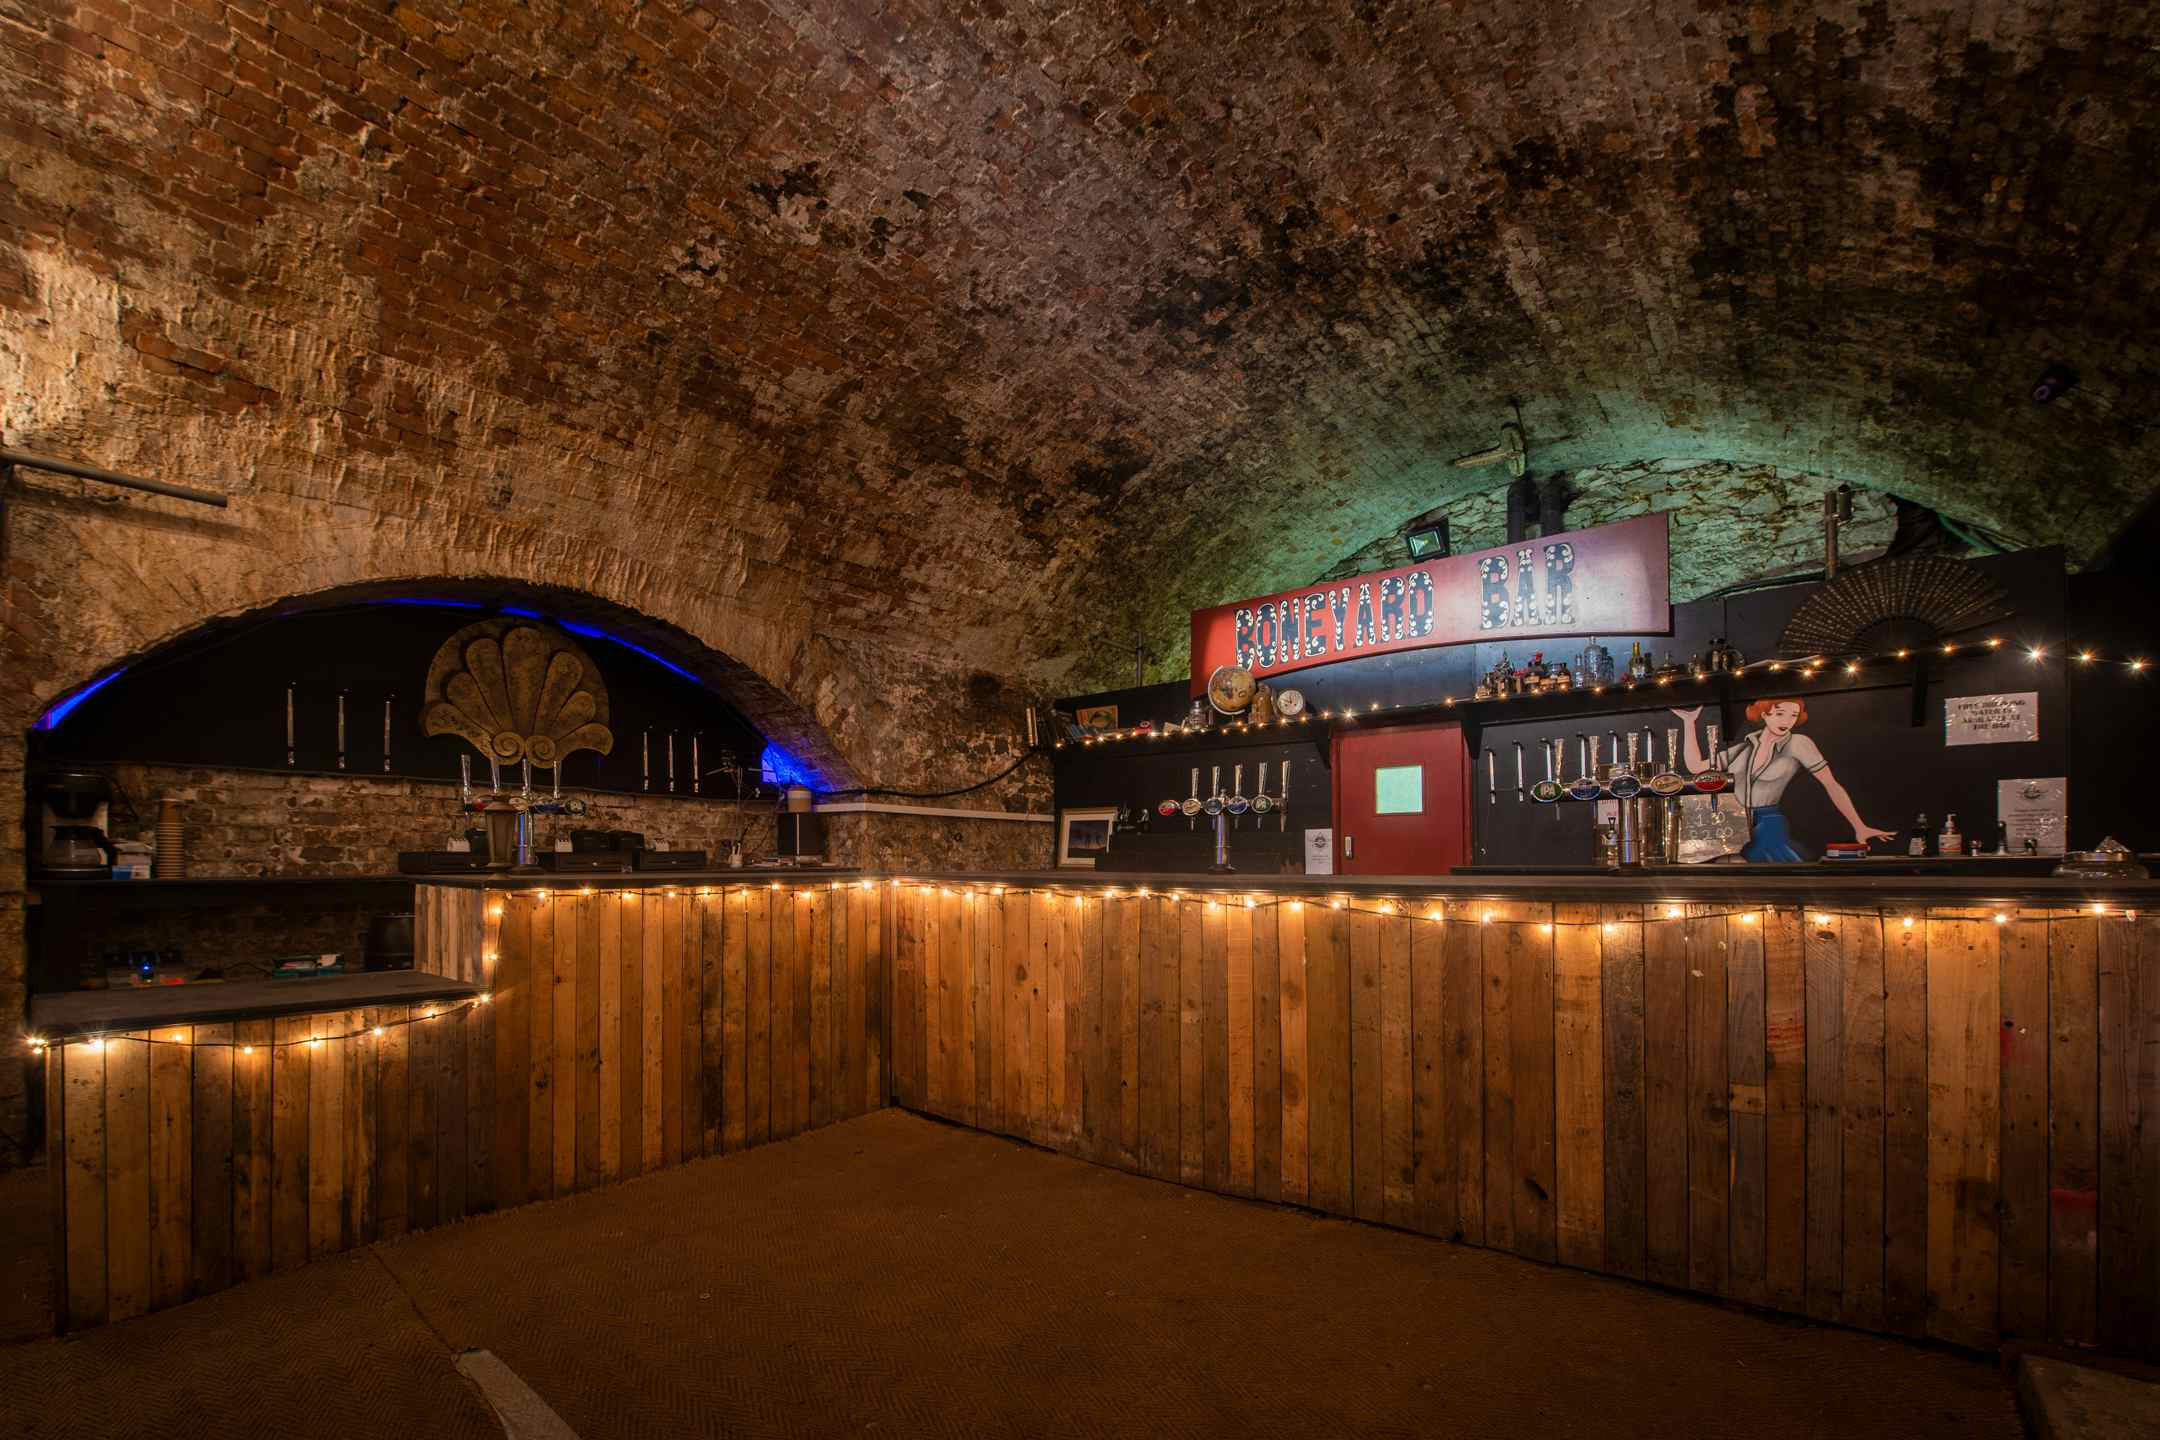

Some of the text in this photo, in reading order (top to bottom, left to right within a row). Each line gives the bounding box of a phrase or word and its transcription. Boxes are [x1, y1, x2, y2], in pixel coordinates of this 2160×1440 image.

[1234, 542, 1576, 670] BONEYARD BAR
[1540, 783, 1556, 797] IPA
